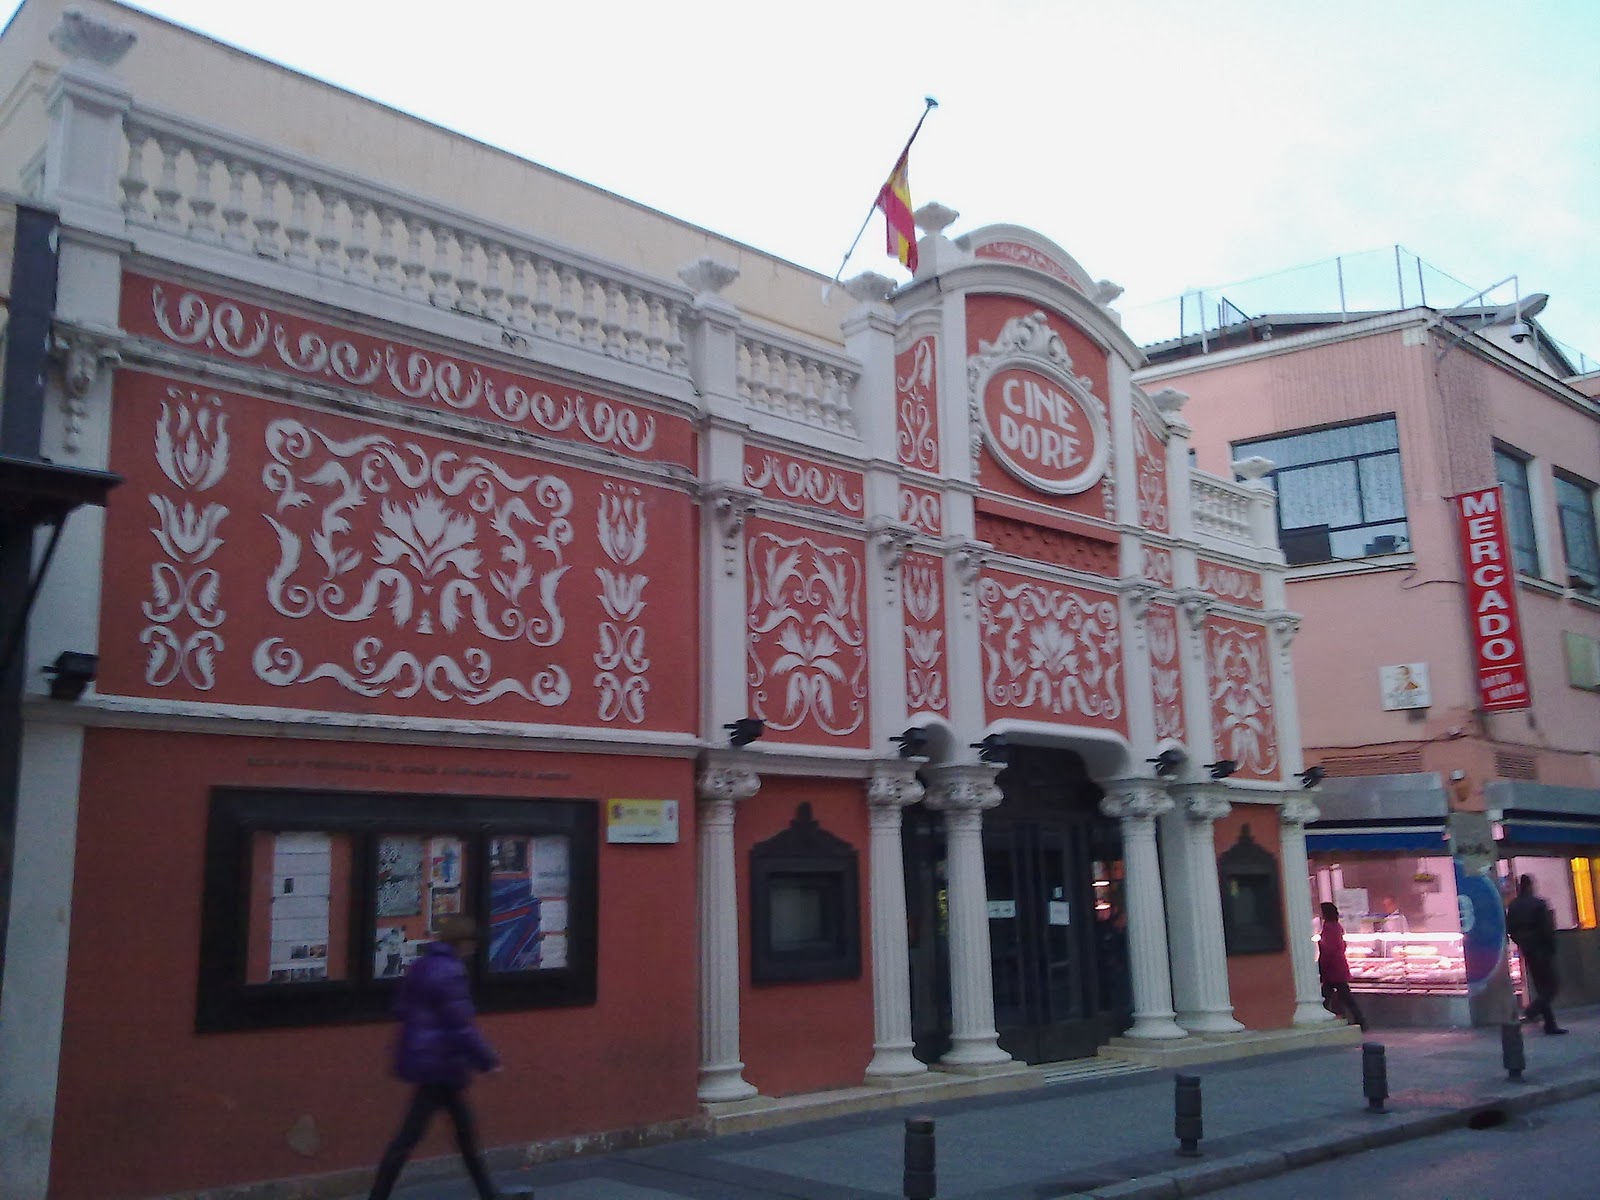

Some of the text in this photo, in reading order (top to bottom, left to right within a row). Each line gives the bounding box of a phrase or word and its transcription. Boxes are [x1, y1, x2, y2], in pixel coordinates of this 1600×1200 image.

[1003, 379, 1077, 432] CINE
[1000, 414, 1083, 469] DORE
[1461, 491, 1516, 661] MERCADO
